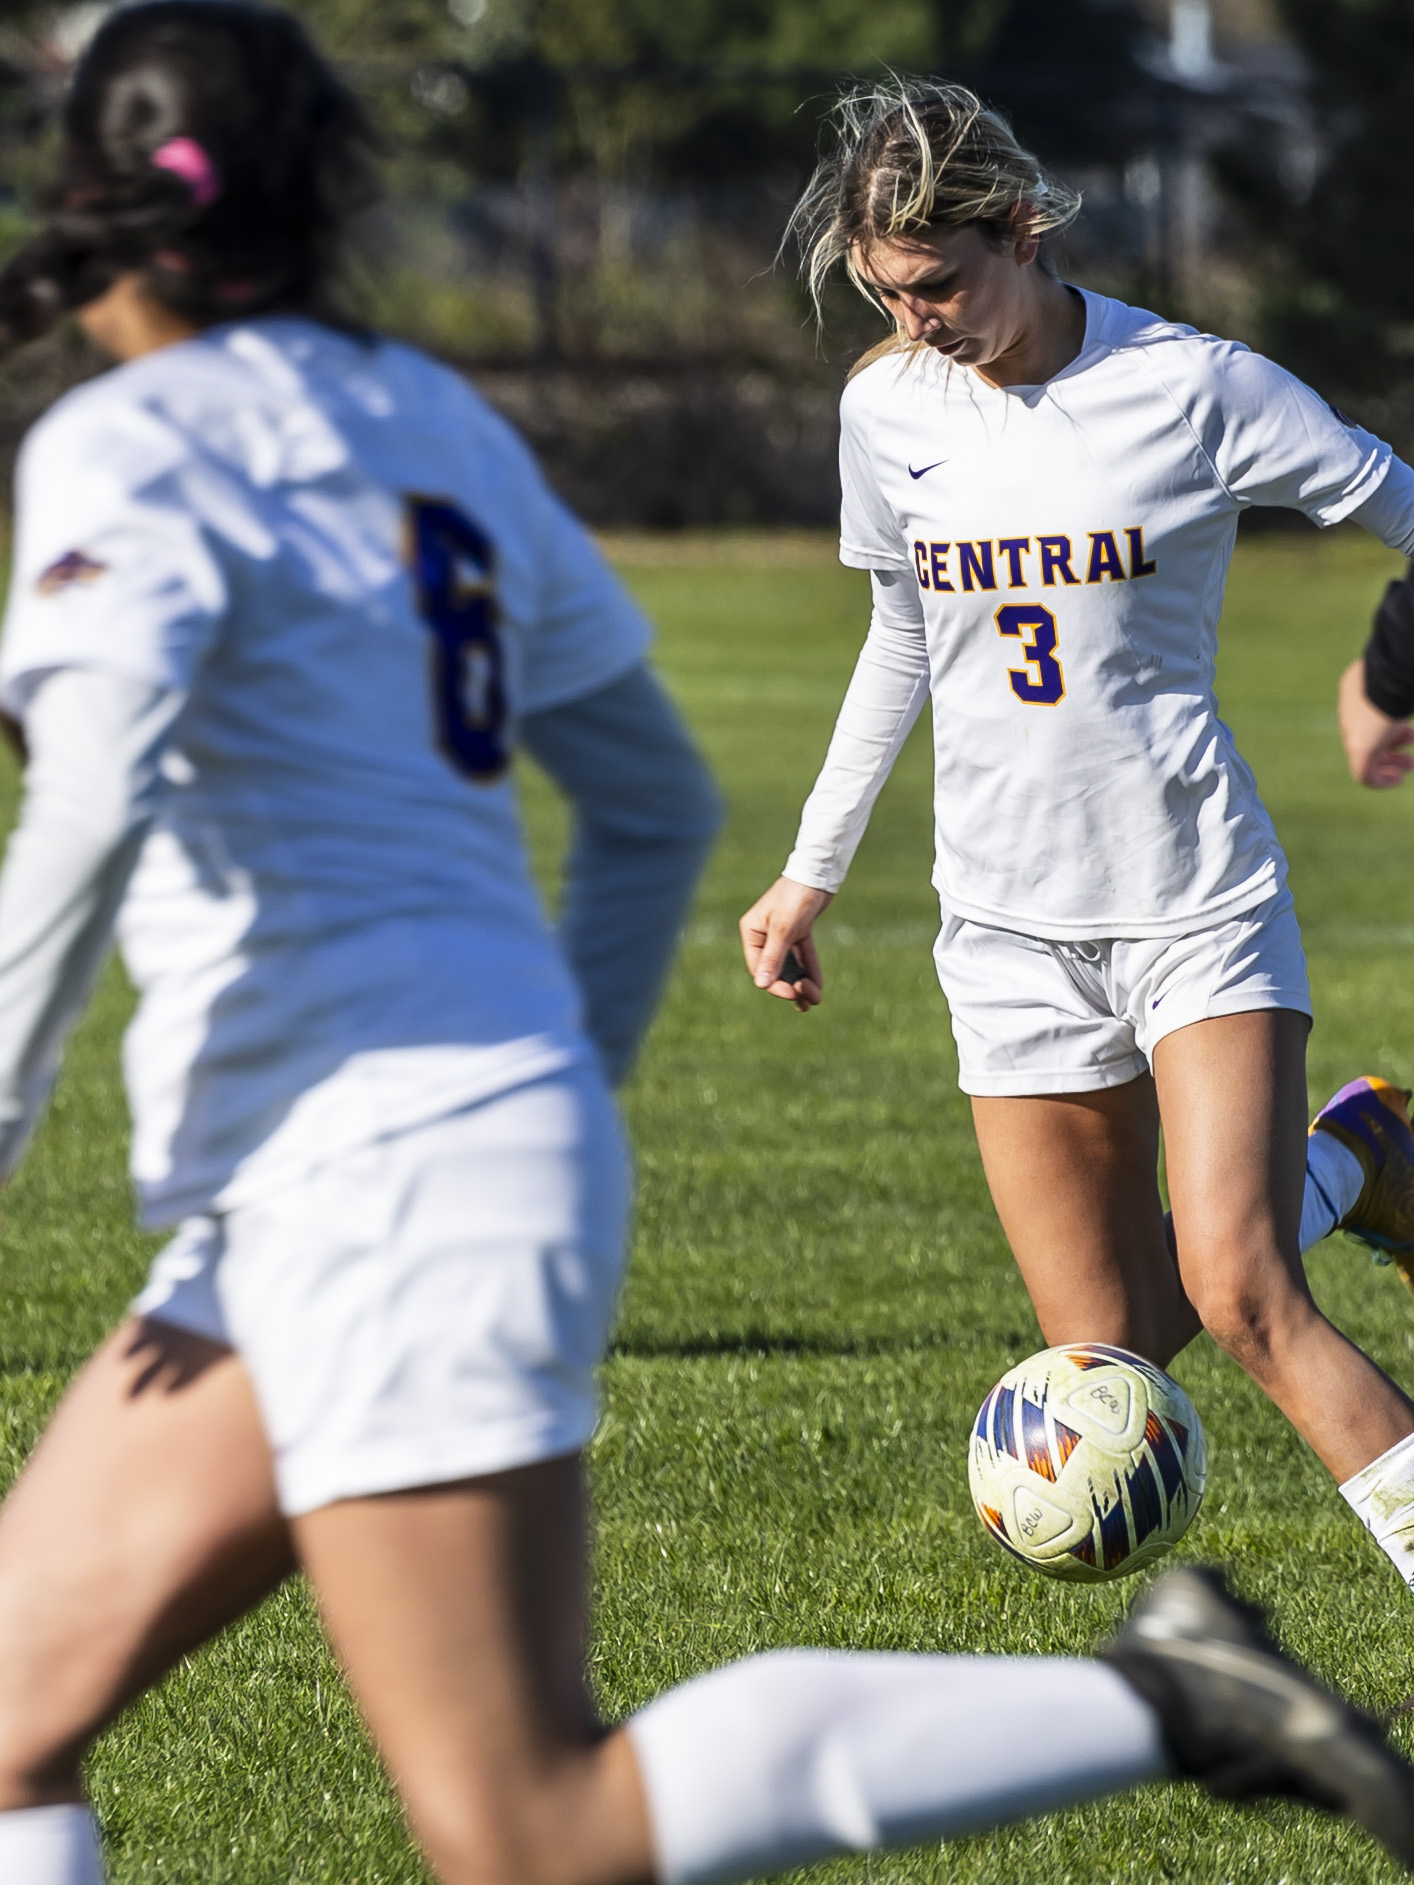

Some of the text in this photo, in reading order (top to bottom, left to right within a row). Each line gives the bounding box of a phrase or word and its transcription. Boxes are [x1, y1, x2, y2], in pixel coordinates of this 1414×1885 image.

[913, 526, 1157, 593] CENTRAL
[399, 493, 509, 785] 6
[993, 602, 1067, 707] 3
